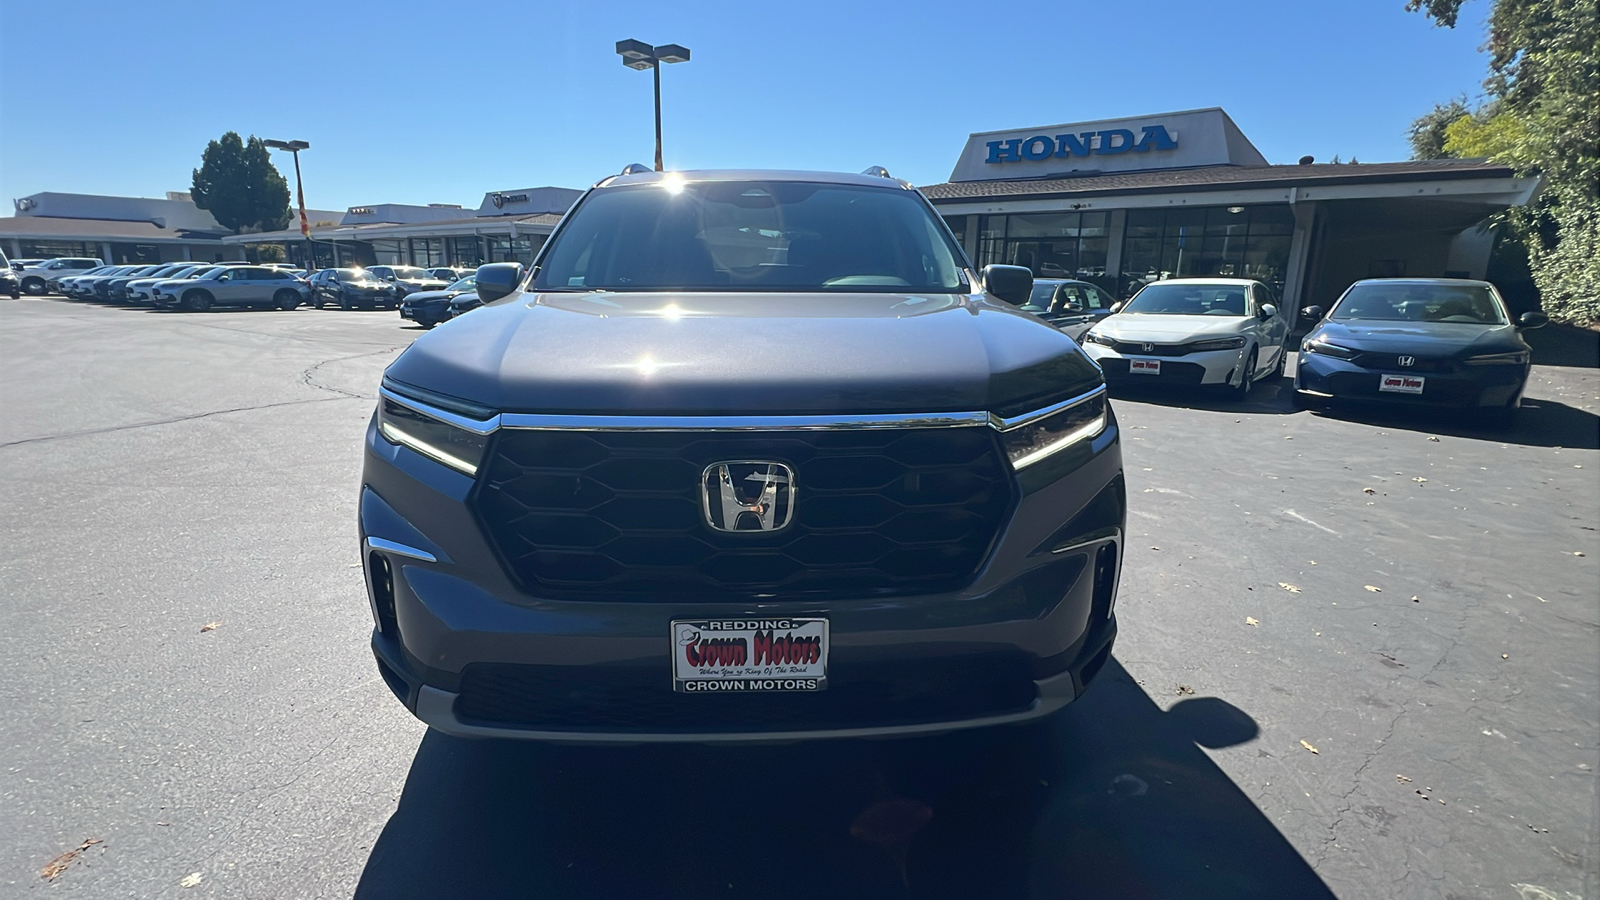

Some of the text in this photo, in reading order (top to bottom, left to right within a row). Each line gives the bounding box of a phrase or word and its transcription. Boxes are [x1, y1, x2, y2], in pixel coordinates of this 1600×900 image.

[985, 125, 1178, 164] HONDA
[709, 620, 790, 630] REDDING
[685, 629, 822, 667] Crown Motors
[745, 667, 761, 676] King
[763, 666, 773, 675] Of
[774, 666, 787, 674] The
[789, 665, 808, 673] Road
[685, 679, 817, 691] CROWN MOTORS
